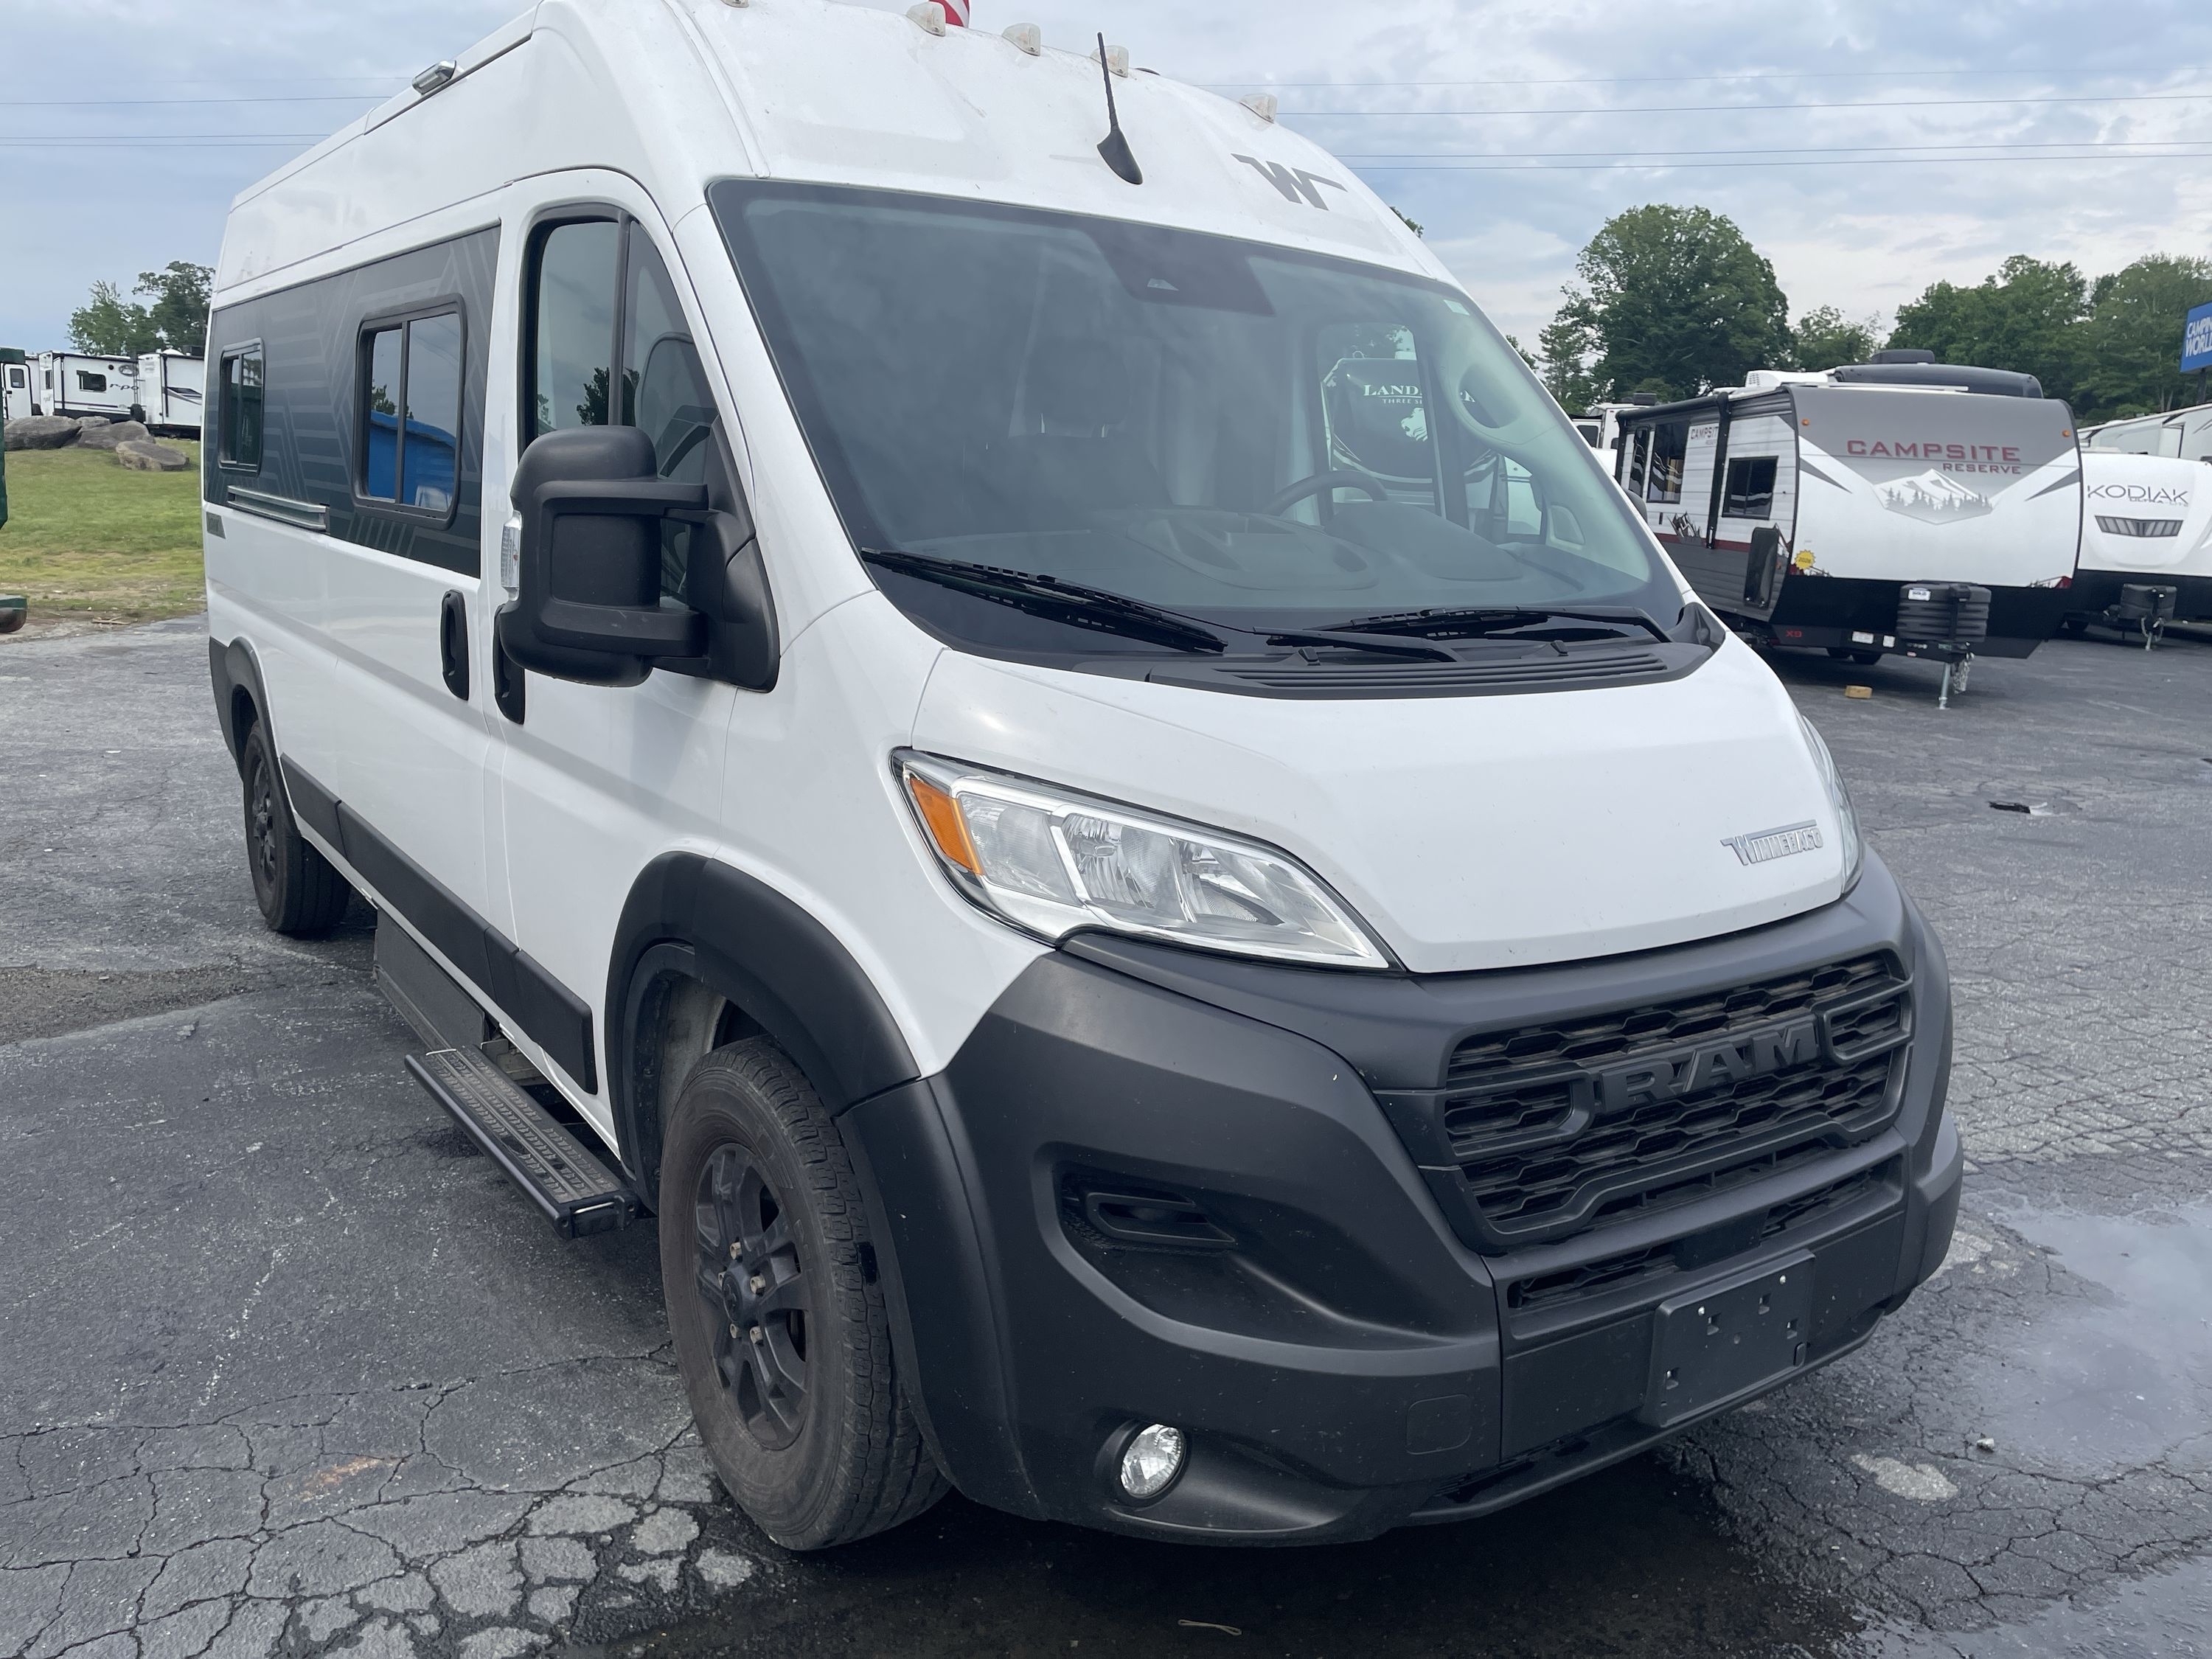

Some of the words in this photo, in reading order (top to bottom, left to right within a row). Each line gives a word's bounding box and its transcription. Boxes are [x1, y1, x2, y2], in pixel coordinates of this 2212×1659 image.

[1691, 427, 1719, 439] CAMPSIT
[1847, 440, 2021, 462] CAMPSITE
[1943, 463, 2021, 474] RESERVE
[2087, 484, 2188, 504] KODIAK
[1720, 819, 1823, 866] WINNEBAGO
[1601, 1019, 1819, 1112] RAM
